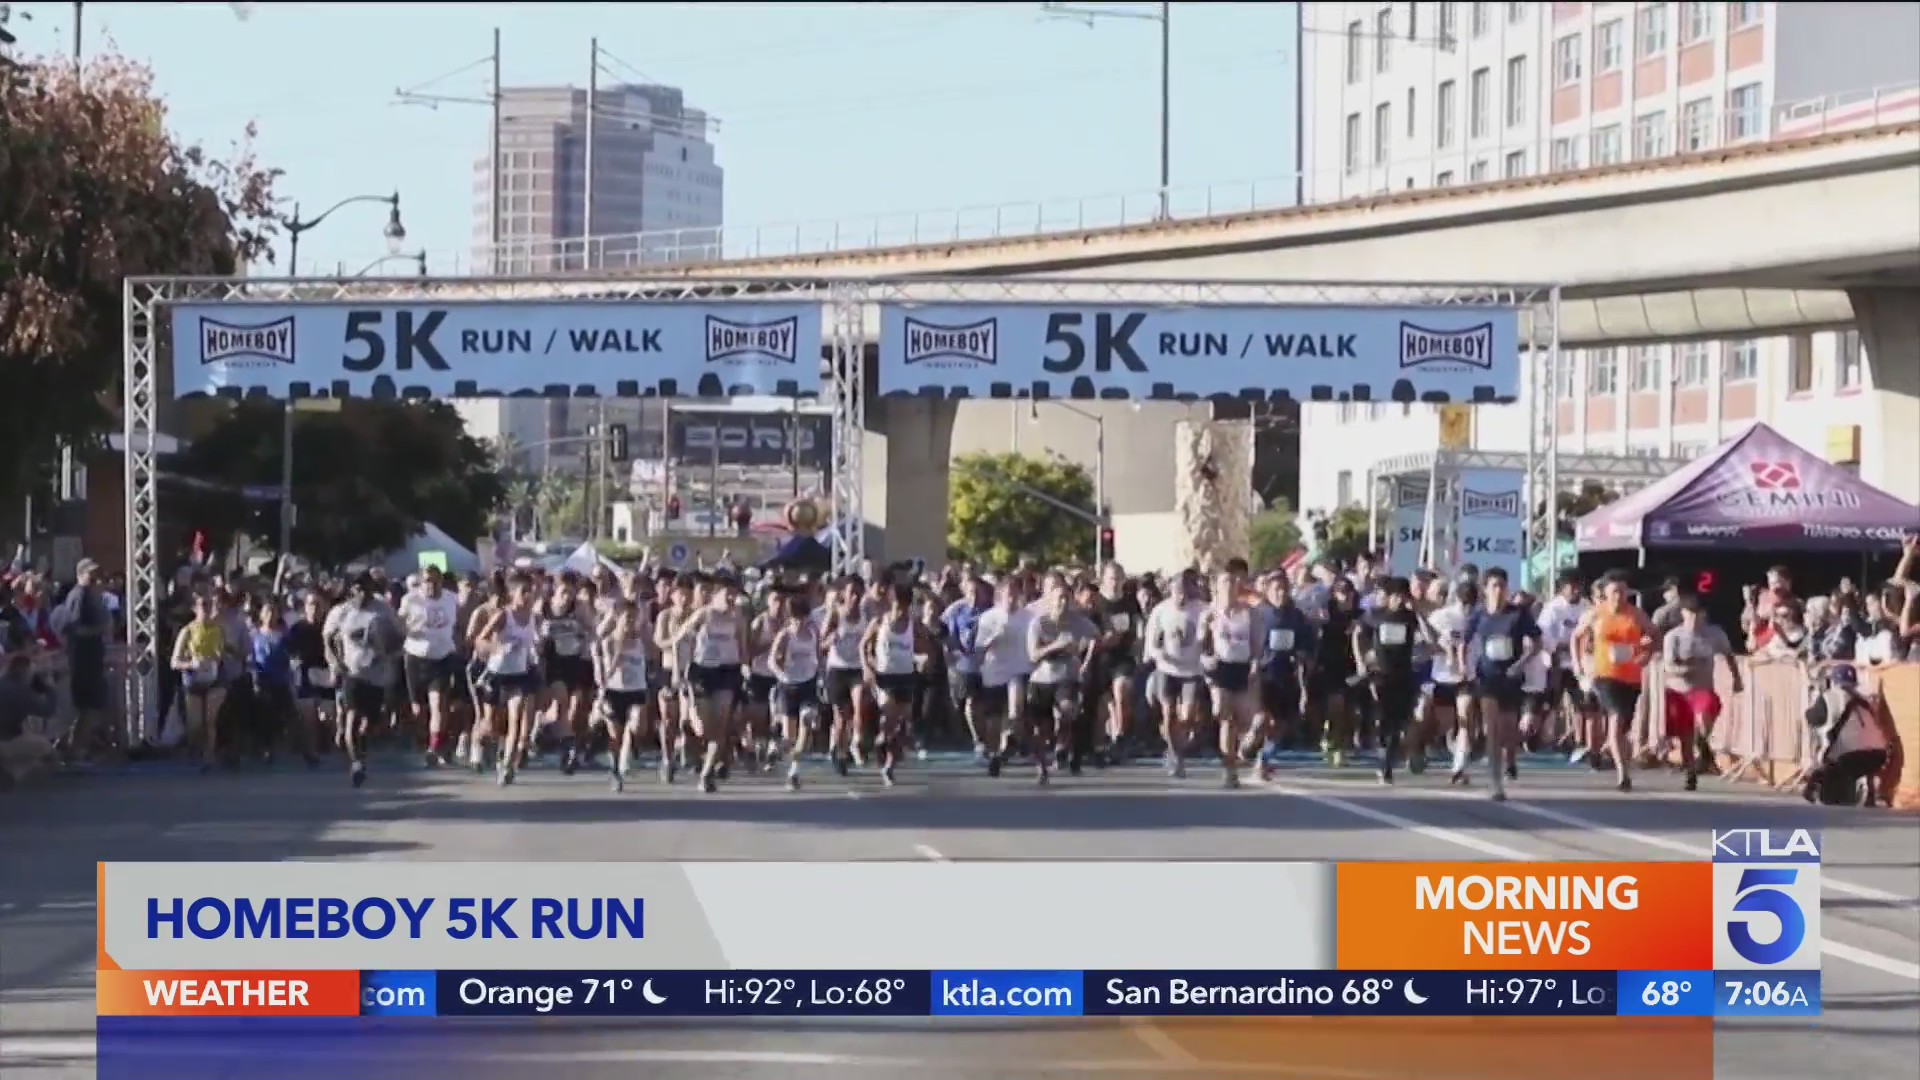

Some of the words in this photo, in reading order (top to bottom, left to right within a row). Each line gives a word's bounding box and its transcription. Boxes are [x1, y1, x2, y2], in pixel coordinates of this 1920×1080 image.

[207, 328, 288, 354] HOMEBOY
[342, 310, 451, 372] 5K
[462, 328, 531, 353] RUN
[569, 328, 663, 353] WALK
[713, 326, 790, 353] HOMEBOY
[911, 330, 990, 355] HOMEBOY
[1043, 313, 1149, 373] 5K
[1159, 332, 1228, 356] RUN
[1265, 333, 1358, 358] WALK
[1406, 333, 1486, 360] HOMEBOY
[1463, 537, 1491, 553] 5K
[1697, 571, 1712, 593] 2
